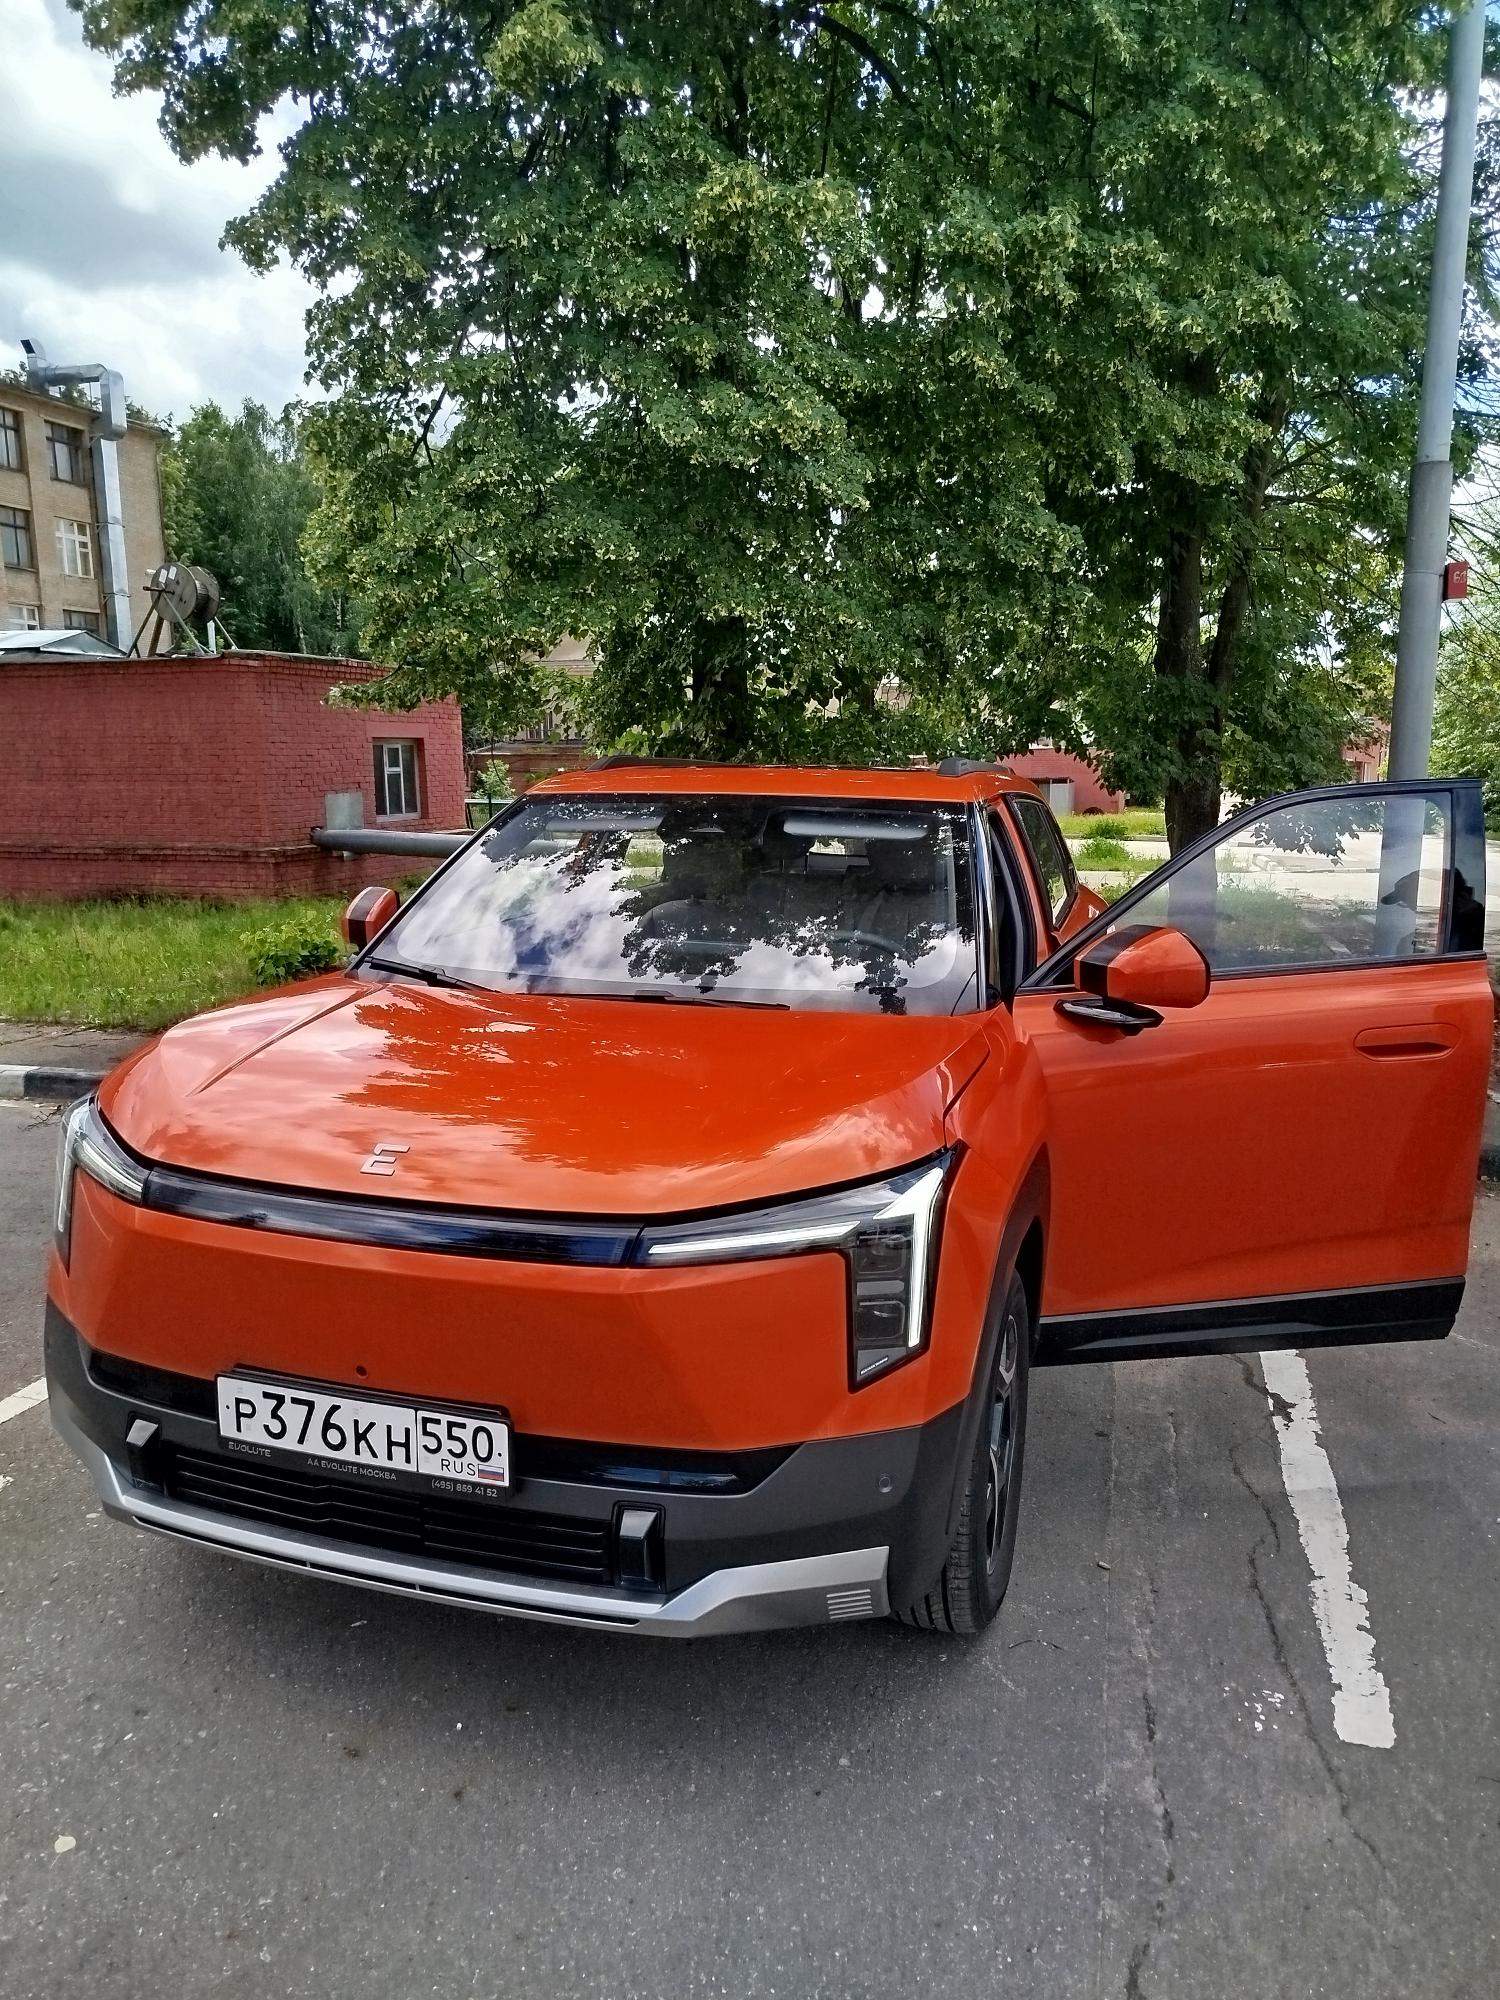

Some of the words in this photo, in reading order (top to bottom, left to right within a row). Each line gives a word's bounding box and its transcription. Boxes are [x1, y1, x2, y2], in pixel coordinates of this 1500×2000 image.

[234, 1390, 412, 1464] Р376КН
[421, 1416, 494, 1463] 550
[228, 1441, 272, 1457] EVOLUTE
[321, 1460, 358, 1474] EVOLUTE
[359, 1467, 397, 1481] МОСКВА
[440, 1458, 476, 1477] RUS
[431, 1479, 454, 1492] (495)
[456, 1483, 473, 1493] 859
[475, 1486, 484, 1495] 41
[486, 1488, 498, 1498] 52
